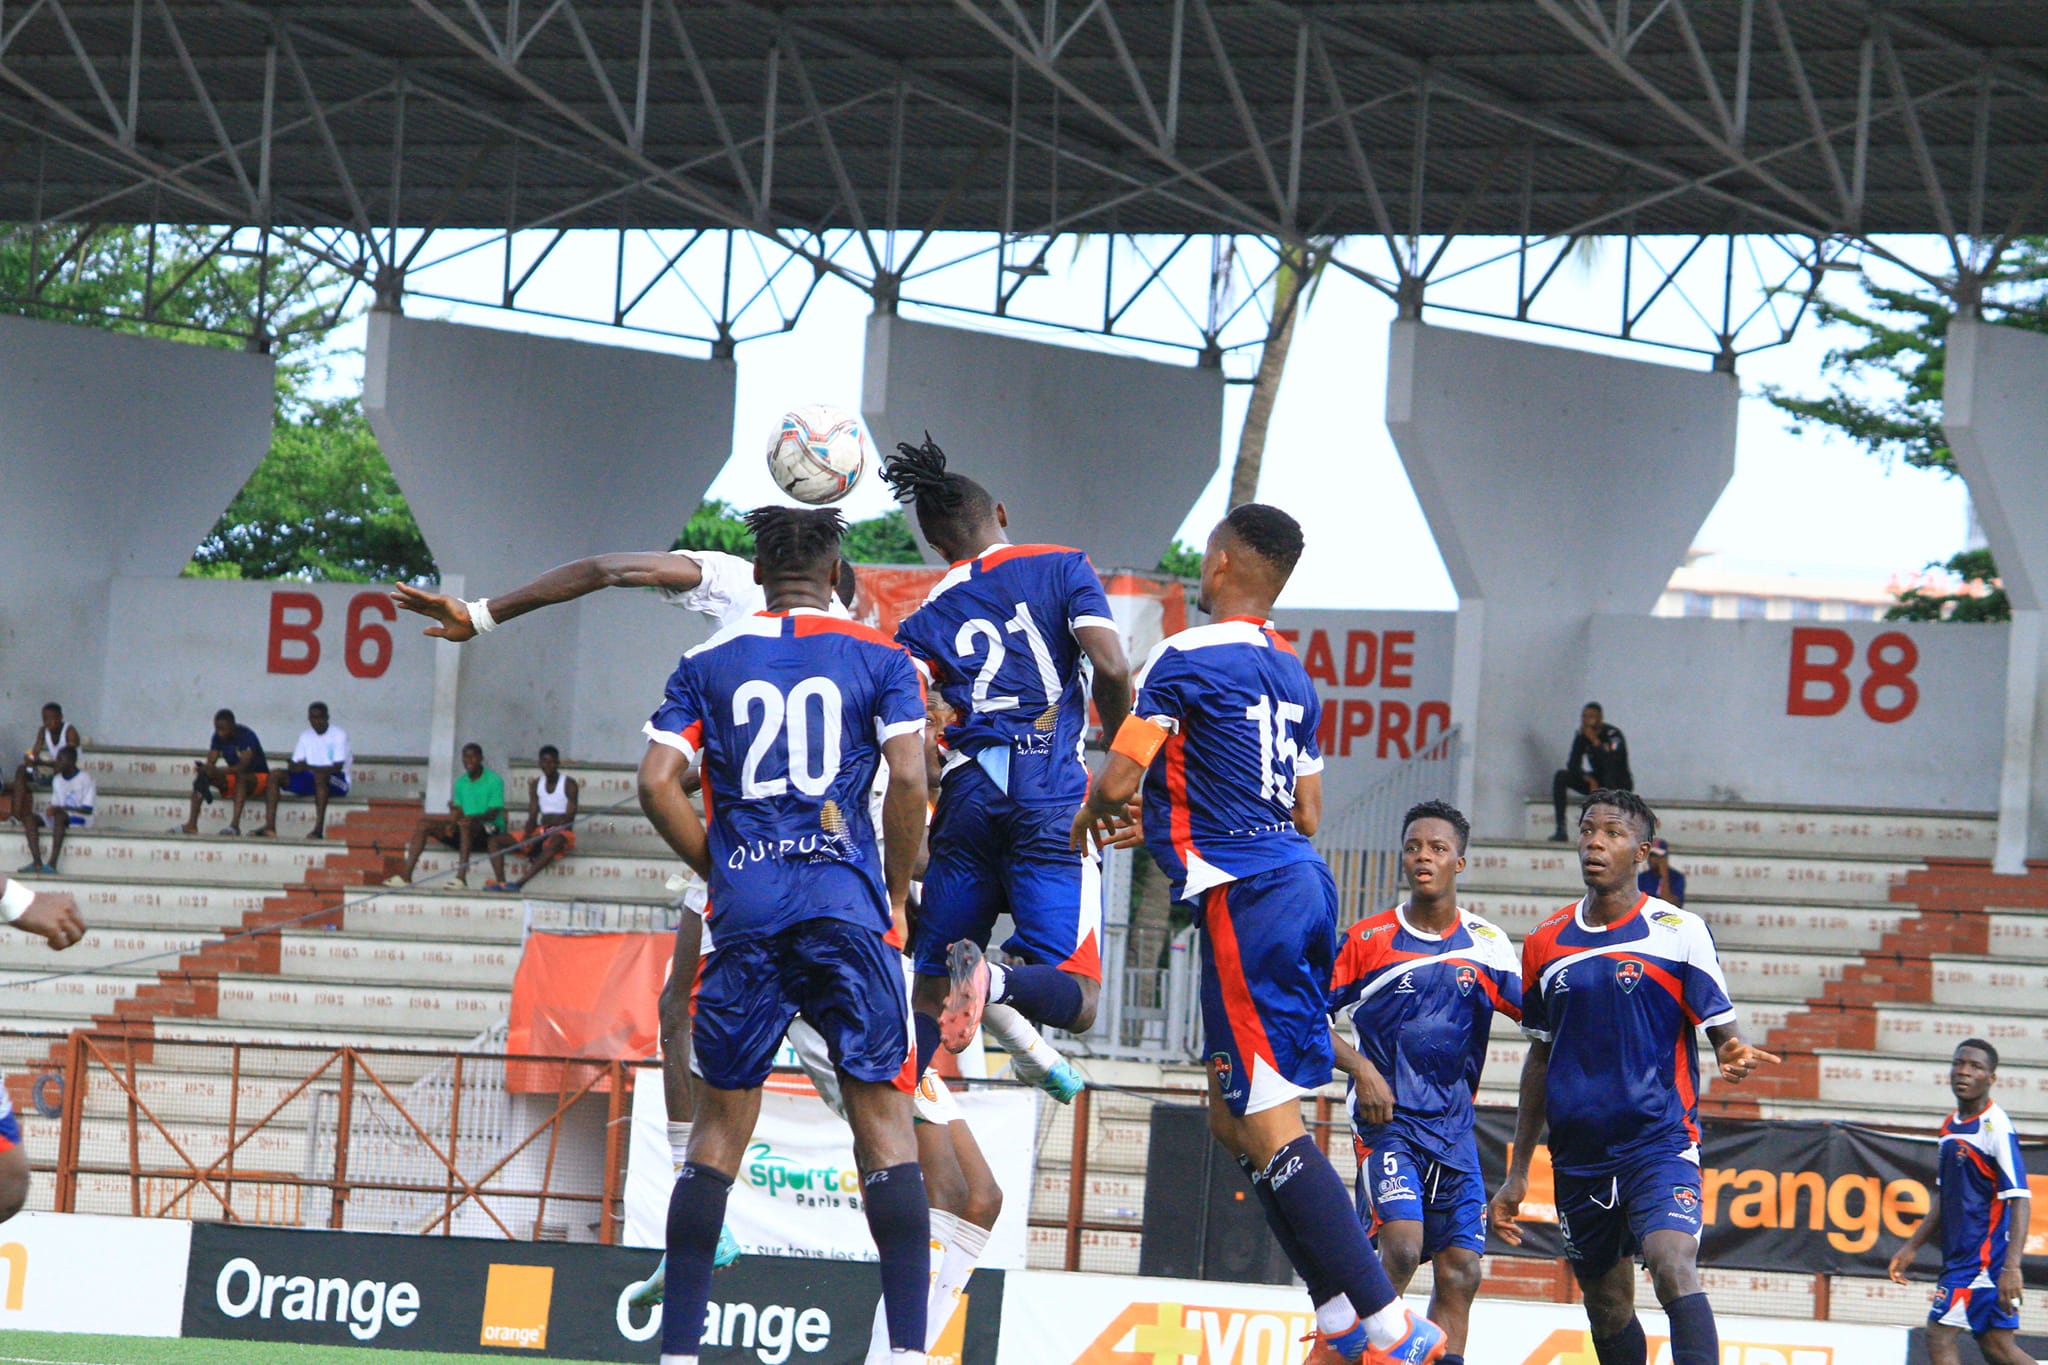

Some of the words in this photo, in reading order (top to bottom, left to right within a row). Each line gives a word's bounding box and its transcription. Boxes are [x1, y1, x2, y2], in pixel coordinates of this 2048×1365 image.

[267, 591, 397, 679] B6
[955, 602, 1064, 713] 21
[1280, 629, 1415, 688] ADE
[1786, 627, 1920, 724] B8
[732, 676, 843, 800] 20
[1246, 694, 1304, 809] 15
[750, 1163, 858, 1197] sportc
[796, 1193, 841, 1208] Paris
[1383, 1151, 1398, 1176] 5
[1703, 1168, 1931, 1254] range
[216, 1257, 421, 1341] Orange
[484, 1326, 540, 1347] orange
[616, 1280, 831, 1365] Oange
